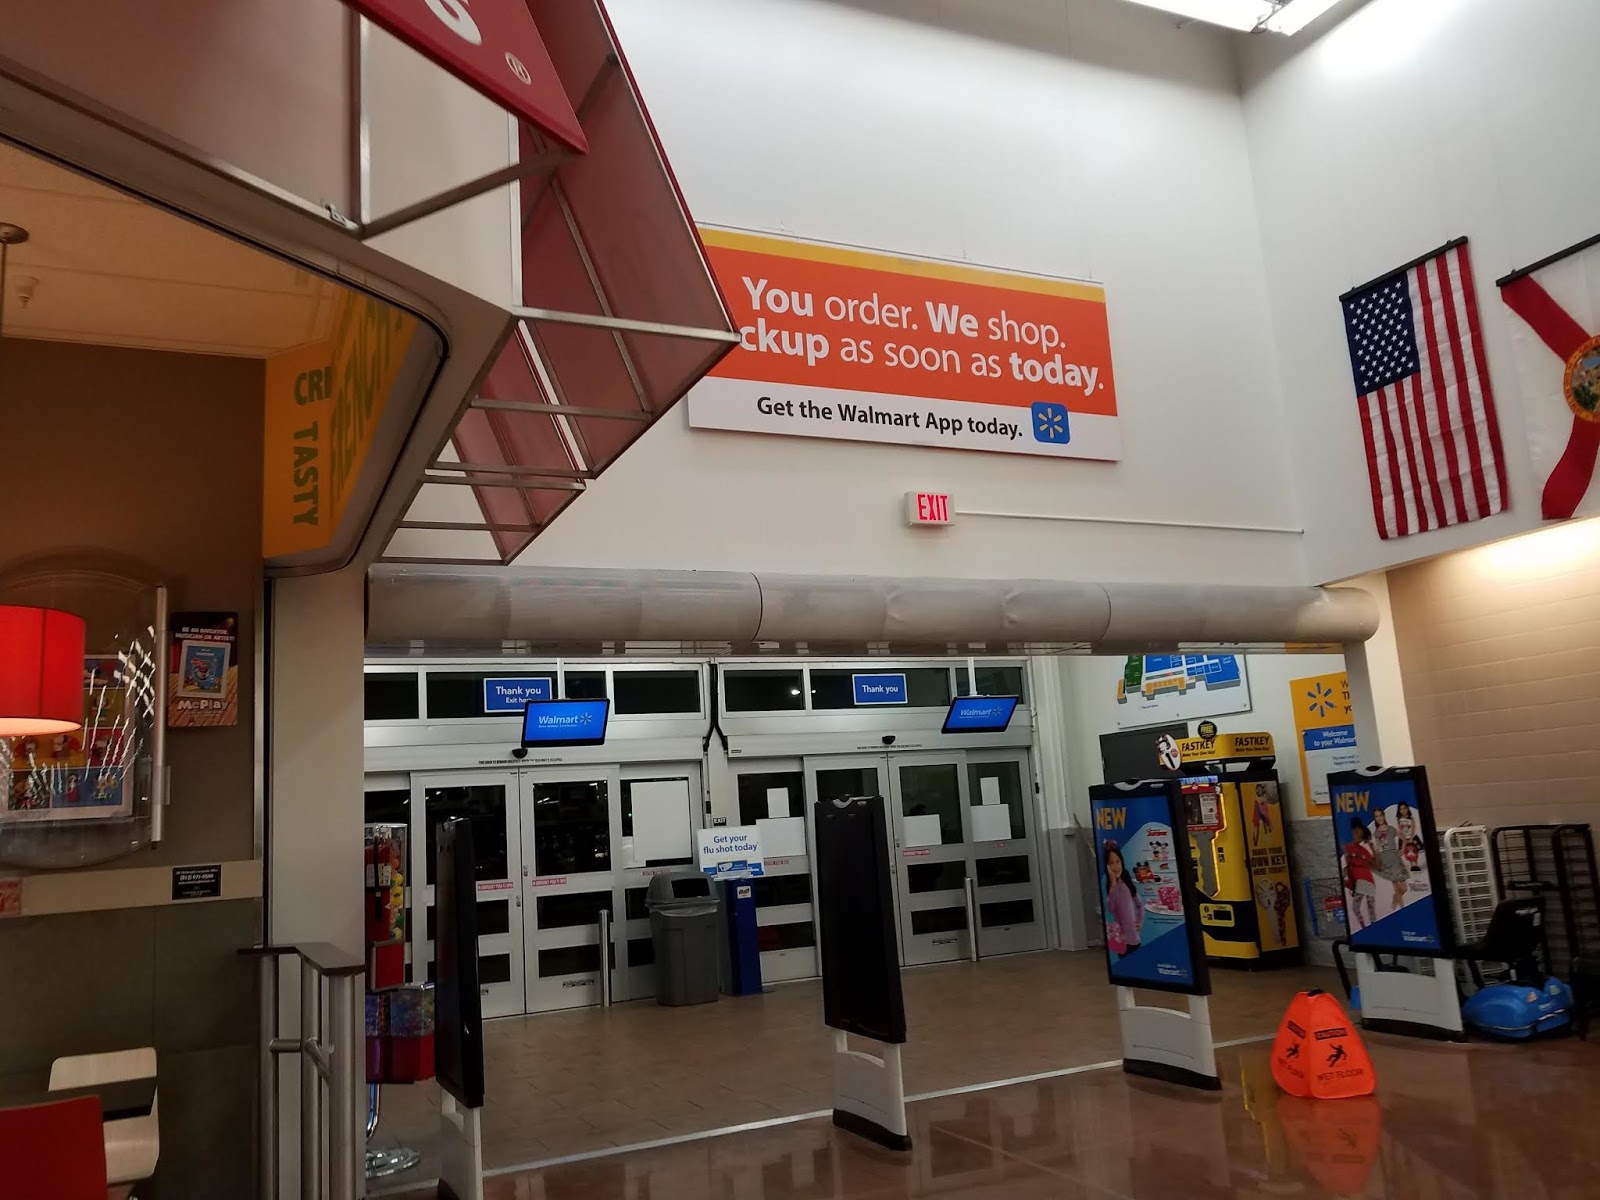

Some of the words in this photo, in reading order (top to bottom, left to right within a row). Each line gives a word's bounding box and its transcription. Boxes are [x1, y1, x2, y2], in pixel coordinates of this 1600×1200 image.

[741, 276, 813, 317] You
[825, 293, 918, 331] order.
[925, 300, 979, 338] We
[988, 310, 1066, 351] shop.
[740, 317, 830, 366] ckup
[840, 336, 874, 364] as
[885, 342, 961, 374] soon
[971, 350, 1001, 378] as
[1009, 353, 1104, 397] today.
[756, 396, 794, 418] Get
[798, 399, 833, 421] the
[837, 403, 920, 429] Walmart
[925, 411, 963, 436] App
[967, 416, 1023, 441] today.
[293, 421, 318, 525] TASTY
[917, 494, 948, 521] EXIT
[496, 686, 523, 695] Thank
[525, 688, 541, 697] you
[862, 685, 884, 693] Thank
[885, 686, 898, 694] you
[177, 699, 228, 710] McPlay
[538, 715, 578, 724] Walmart
[960, 709, 992, 717] Walmart
[1181, 739, 1215, 752] FASTKEY
[1235, 736, 1269, 747] FASTKEY
[1335, 791, 1370, 813] NEW
[1095, 806, 1127, 831] NEW
[713, 835, 728, 843] Get
[729, 835, 747, 844] your
[703, 845, 714, 854] flu
[716, 844, 733, 852] shot
[1251, 856, 1269, 867] OWN
[1270, 854, 1286, 865] KEY
